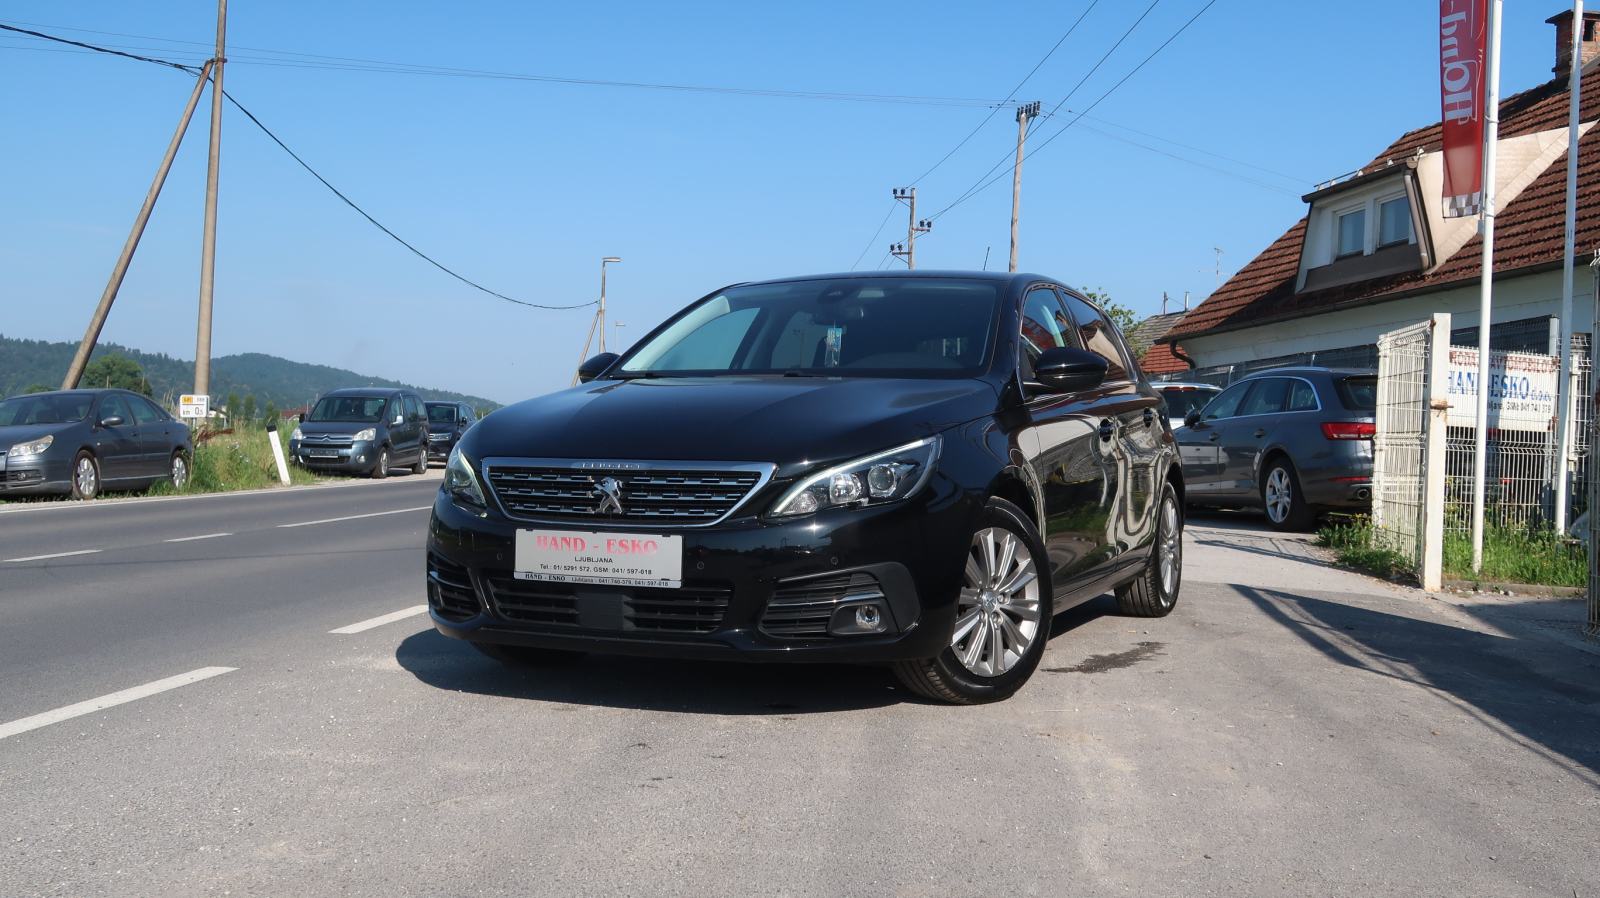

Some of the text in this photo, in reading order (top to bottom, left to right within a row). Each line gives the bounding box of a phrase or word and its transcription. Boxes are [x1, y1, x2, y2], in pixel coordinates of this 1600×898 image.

[1491, 374, 1529, 400] ESKO
[536, 535, 587, 554] HAND
[606, 538, 658, 556] ESKO
[574, 556, 614, 564] LJUBLJANA
[548, 574, 566, 582] ESKO
